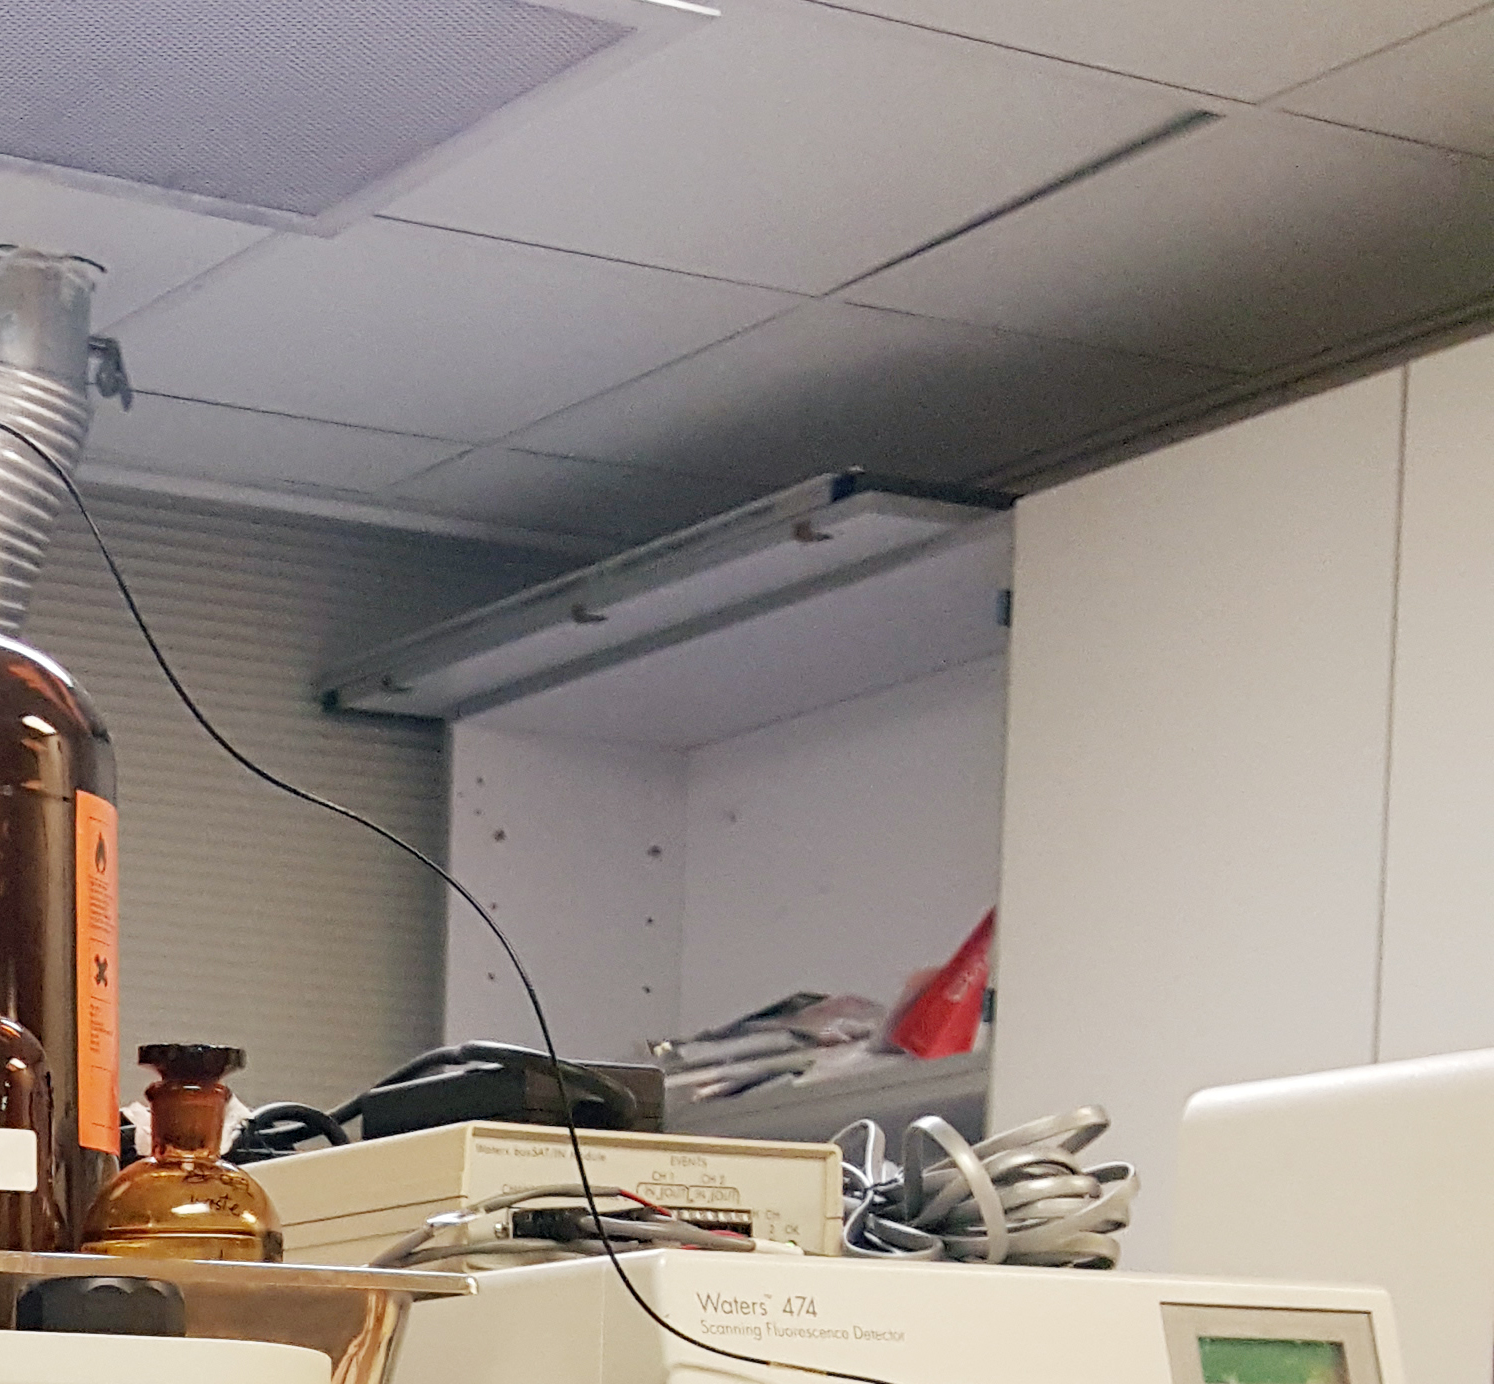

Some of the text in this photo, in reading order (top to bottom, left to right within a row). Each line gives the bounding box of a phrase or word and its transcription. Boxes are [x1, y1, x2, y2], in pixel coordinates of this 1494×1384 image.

[695, 1291, 819, 1318] Waters 474
[700, 1319, 763, 1341] Scanning
